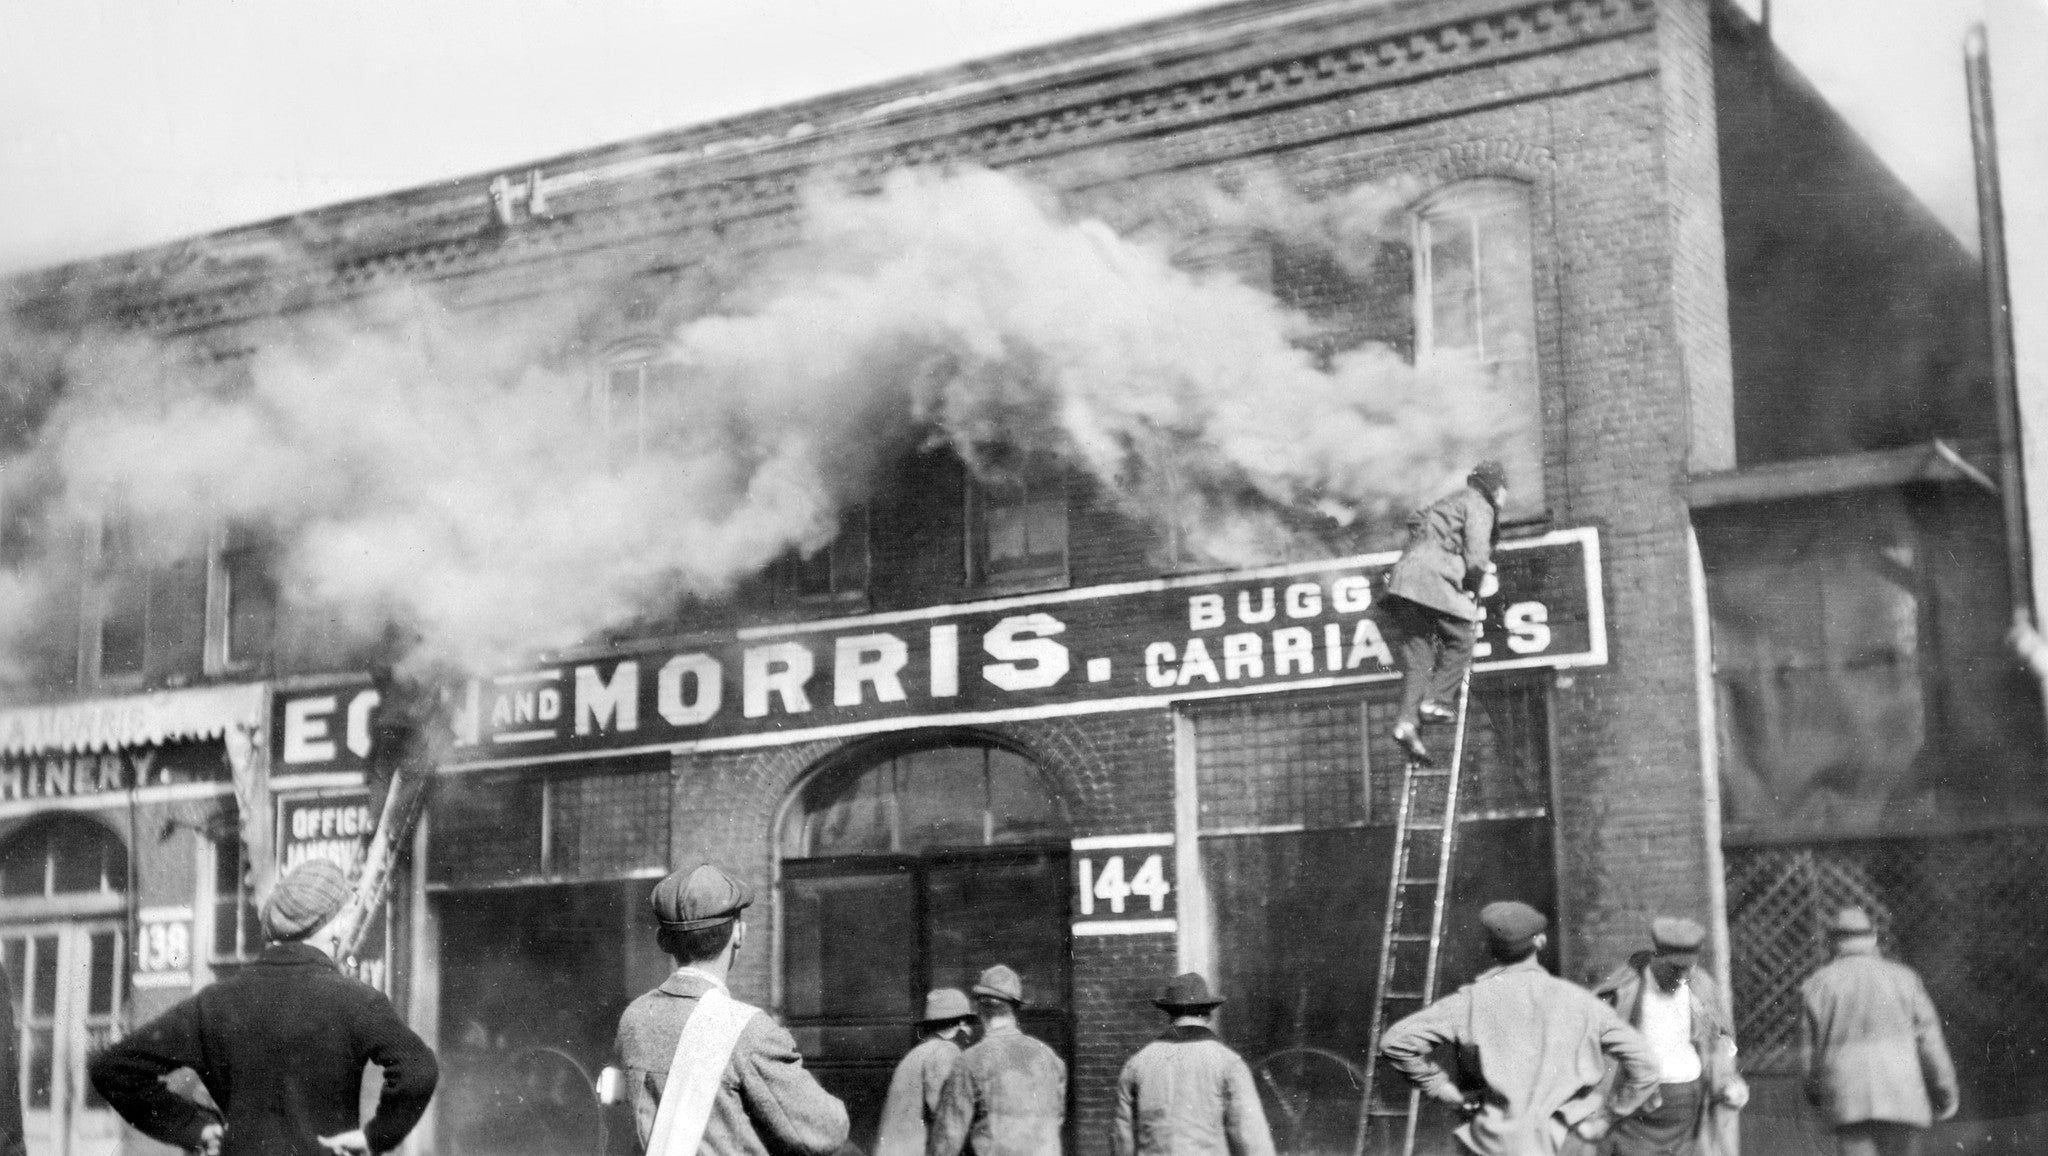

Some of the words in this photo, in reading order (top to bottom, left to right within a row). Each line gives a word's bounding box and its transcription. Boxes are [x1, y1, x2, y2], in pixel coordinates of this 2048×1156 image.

[491, 688, 560, 725] AND
[574, 612, 1112, 737] MORRIS.
[1145, 600, 1551, 688] CARRIAS
[1078, 853, 1171, 916] 144
